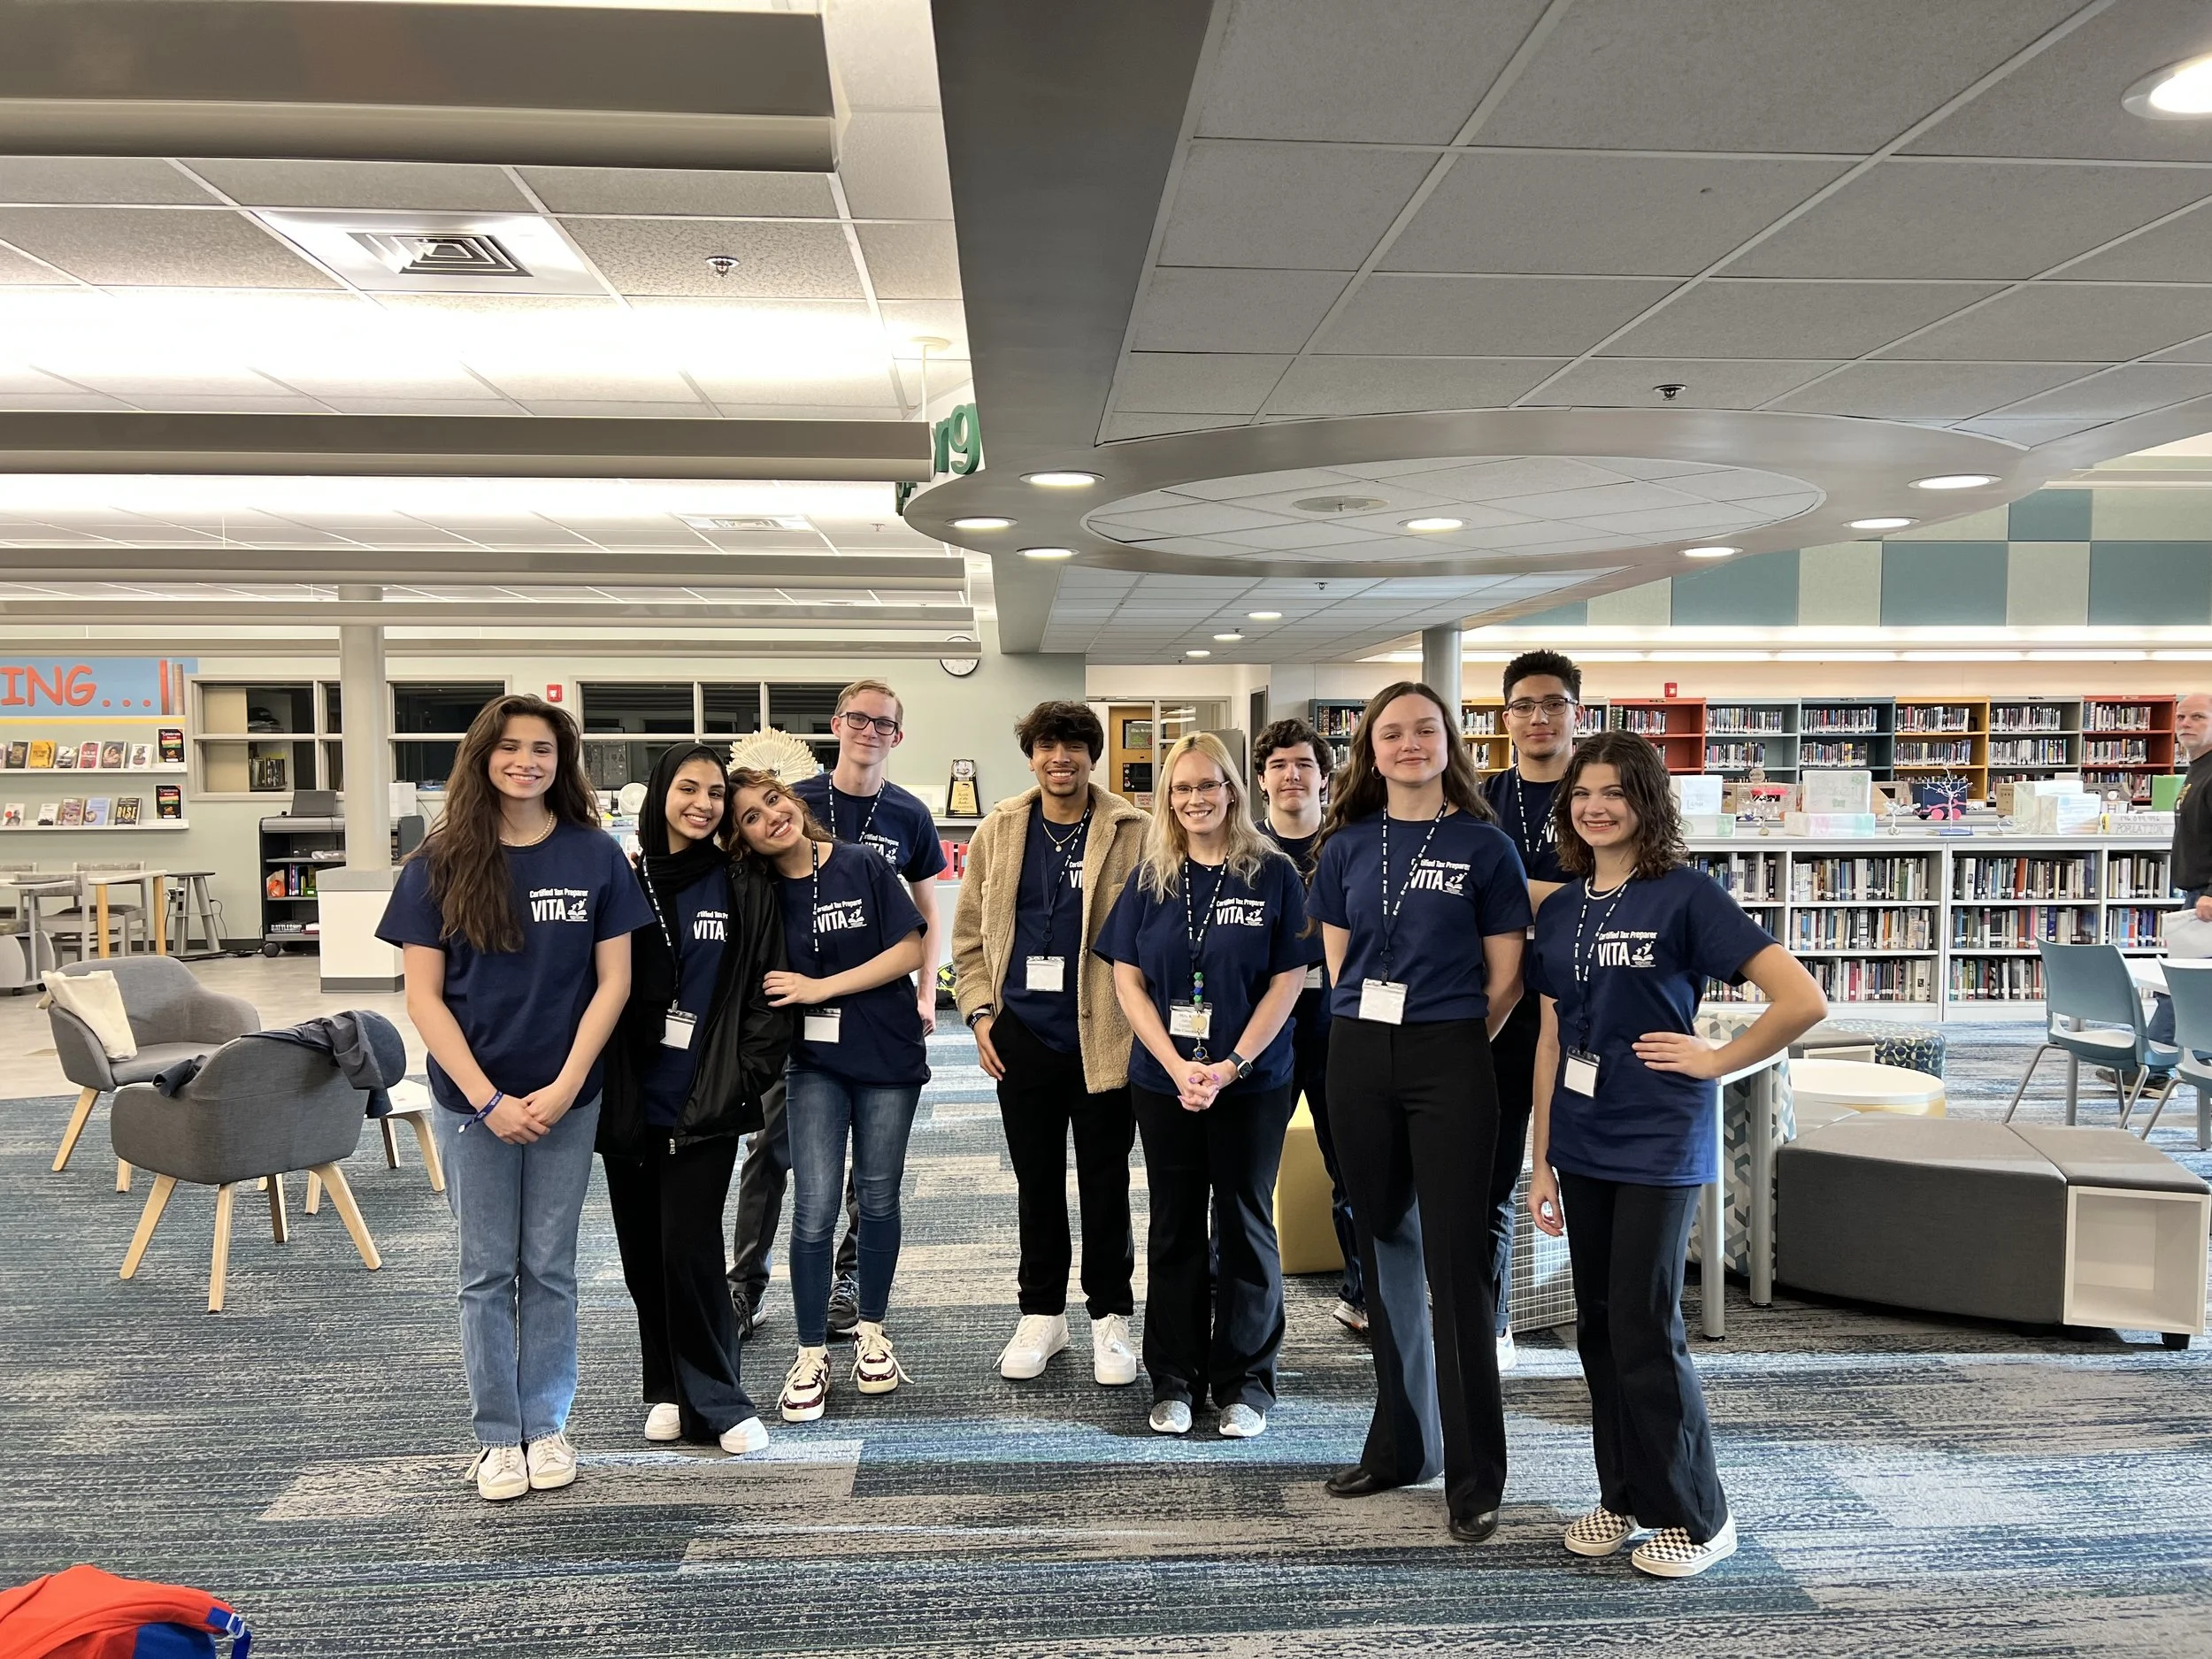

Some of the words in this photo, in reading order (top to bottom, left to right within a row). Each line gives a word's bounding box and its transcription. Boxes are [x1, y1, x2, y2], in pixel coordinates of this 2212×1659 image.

[117, 806, 137, 819] RISE
[1546, 825, 1558, 843] VI
[1069, 870, 1082, 888] VI
[1410, 868, 1444, 891] VITA
[530, 898, 566, 923] VITA
[817, 910, 849, 933] VITA
[1216, 906, 1245, 926] VITA
[693, 919, 725, 941] VITA
[1597, 941, 1631, 967] VITA
